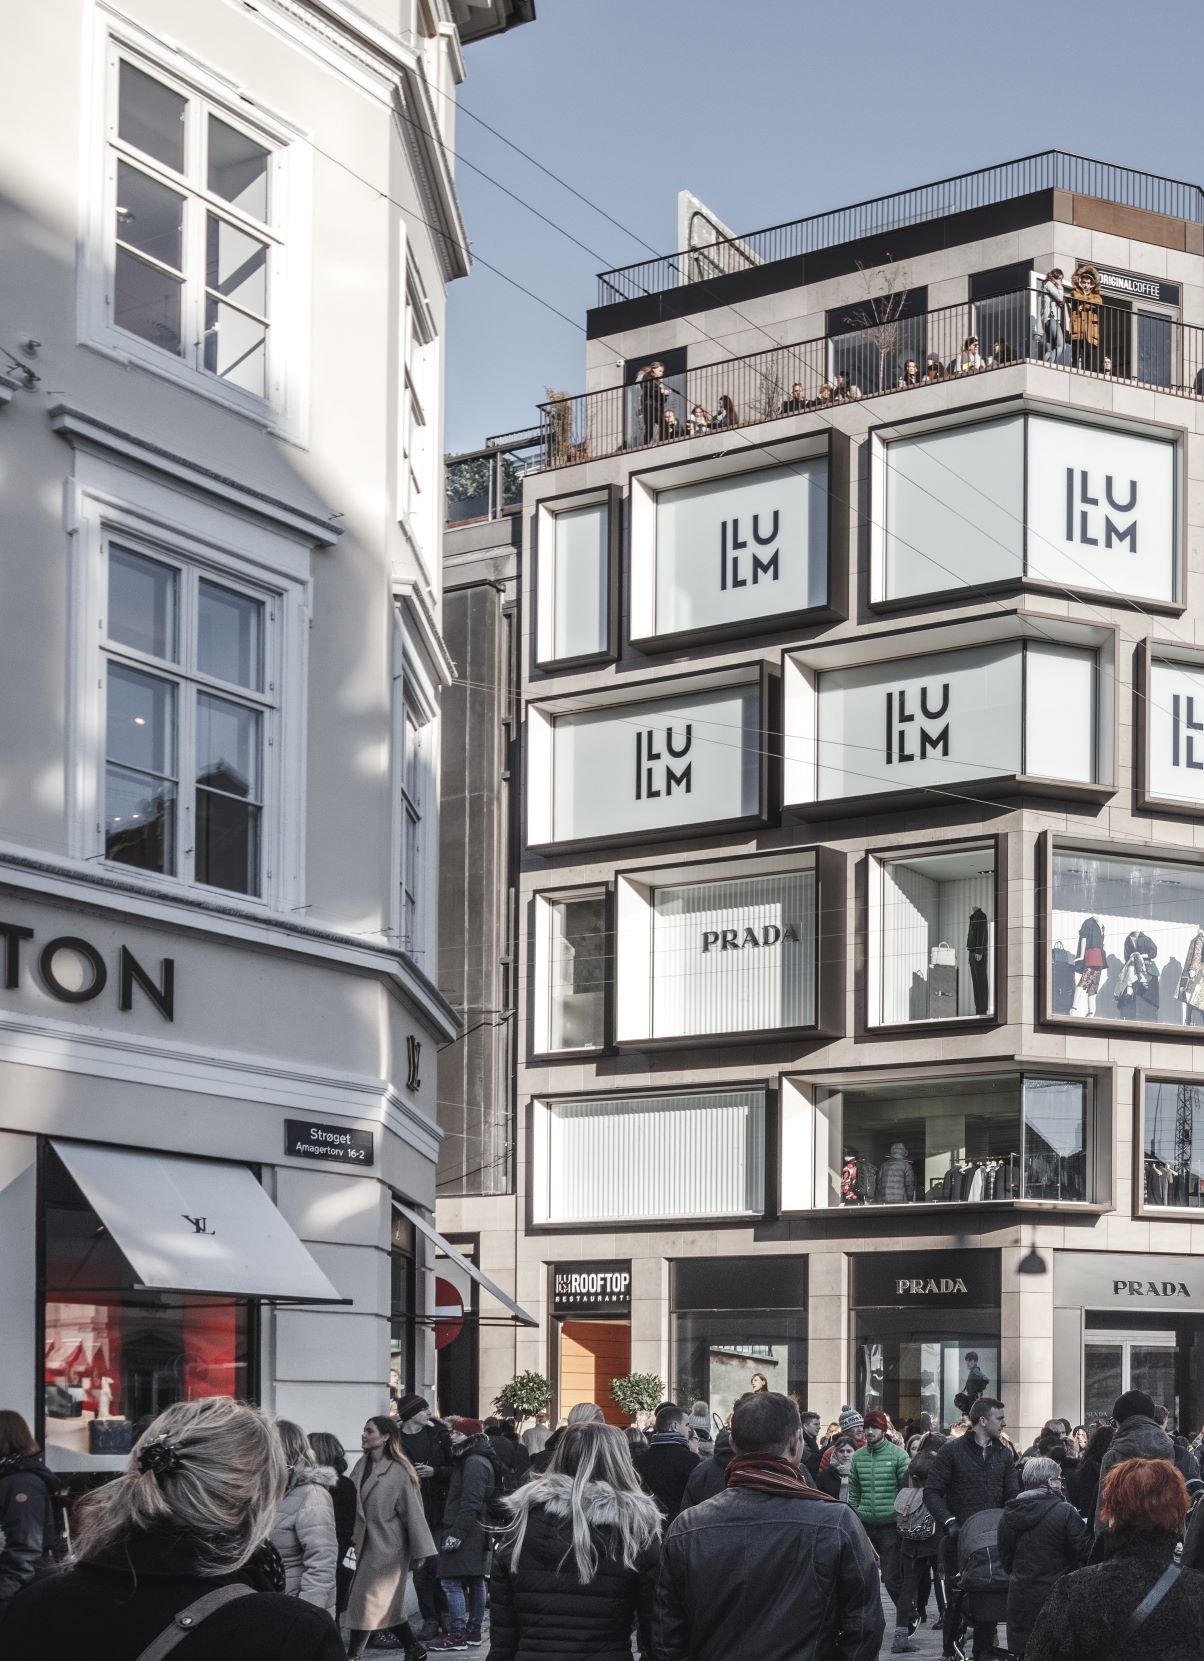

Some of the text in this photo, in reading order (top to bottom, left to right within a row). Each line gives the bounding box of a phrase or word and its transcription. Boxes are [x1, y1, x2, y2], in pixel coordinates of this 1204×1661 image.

[700, 922, 801, 954] PRADA
[310, 1128, 351, 1144] Strøget
[296, 1141, 344, 1156] Amagertorv
[571, 1273, 630, 1293] ROOFTOP
[896, 1278, 968, 1294] PRADA
[1112, 1279, 1191, 1297] PRADA
